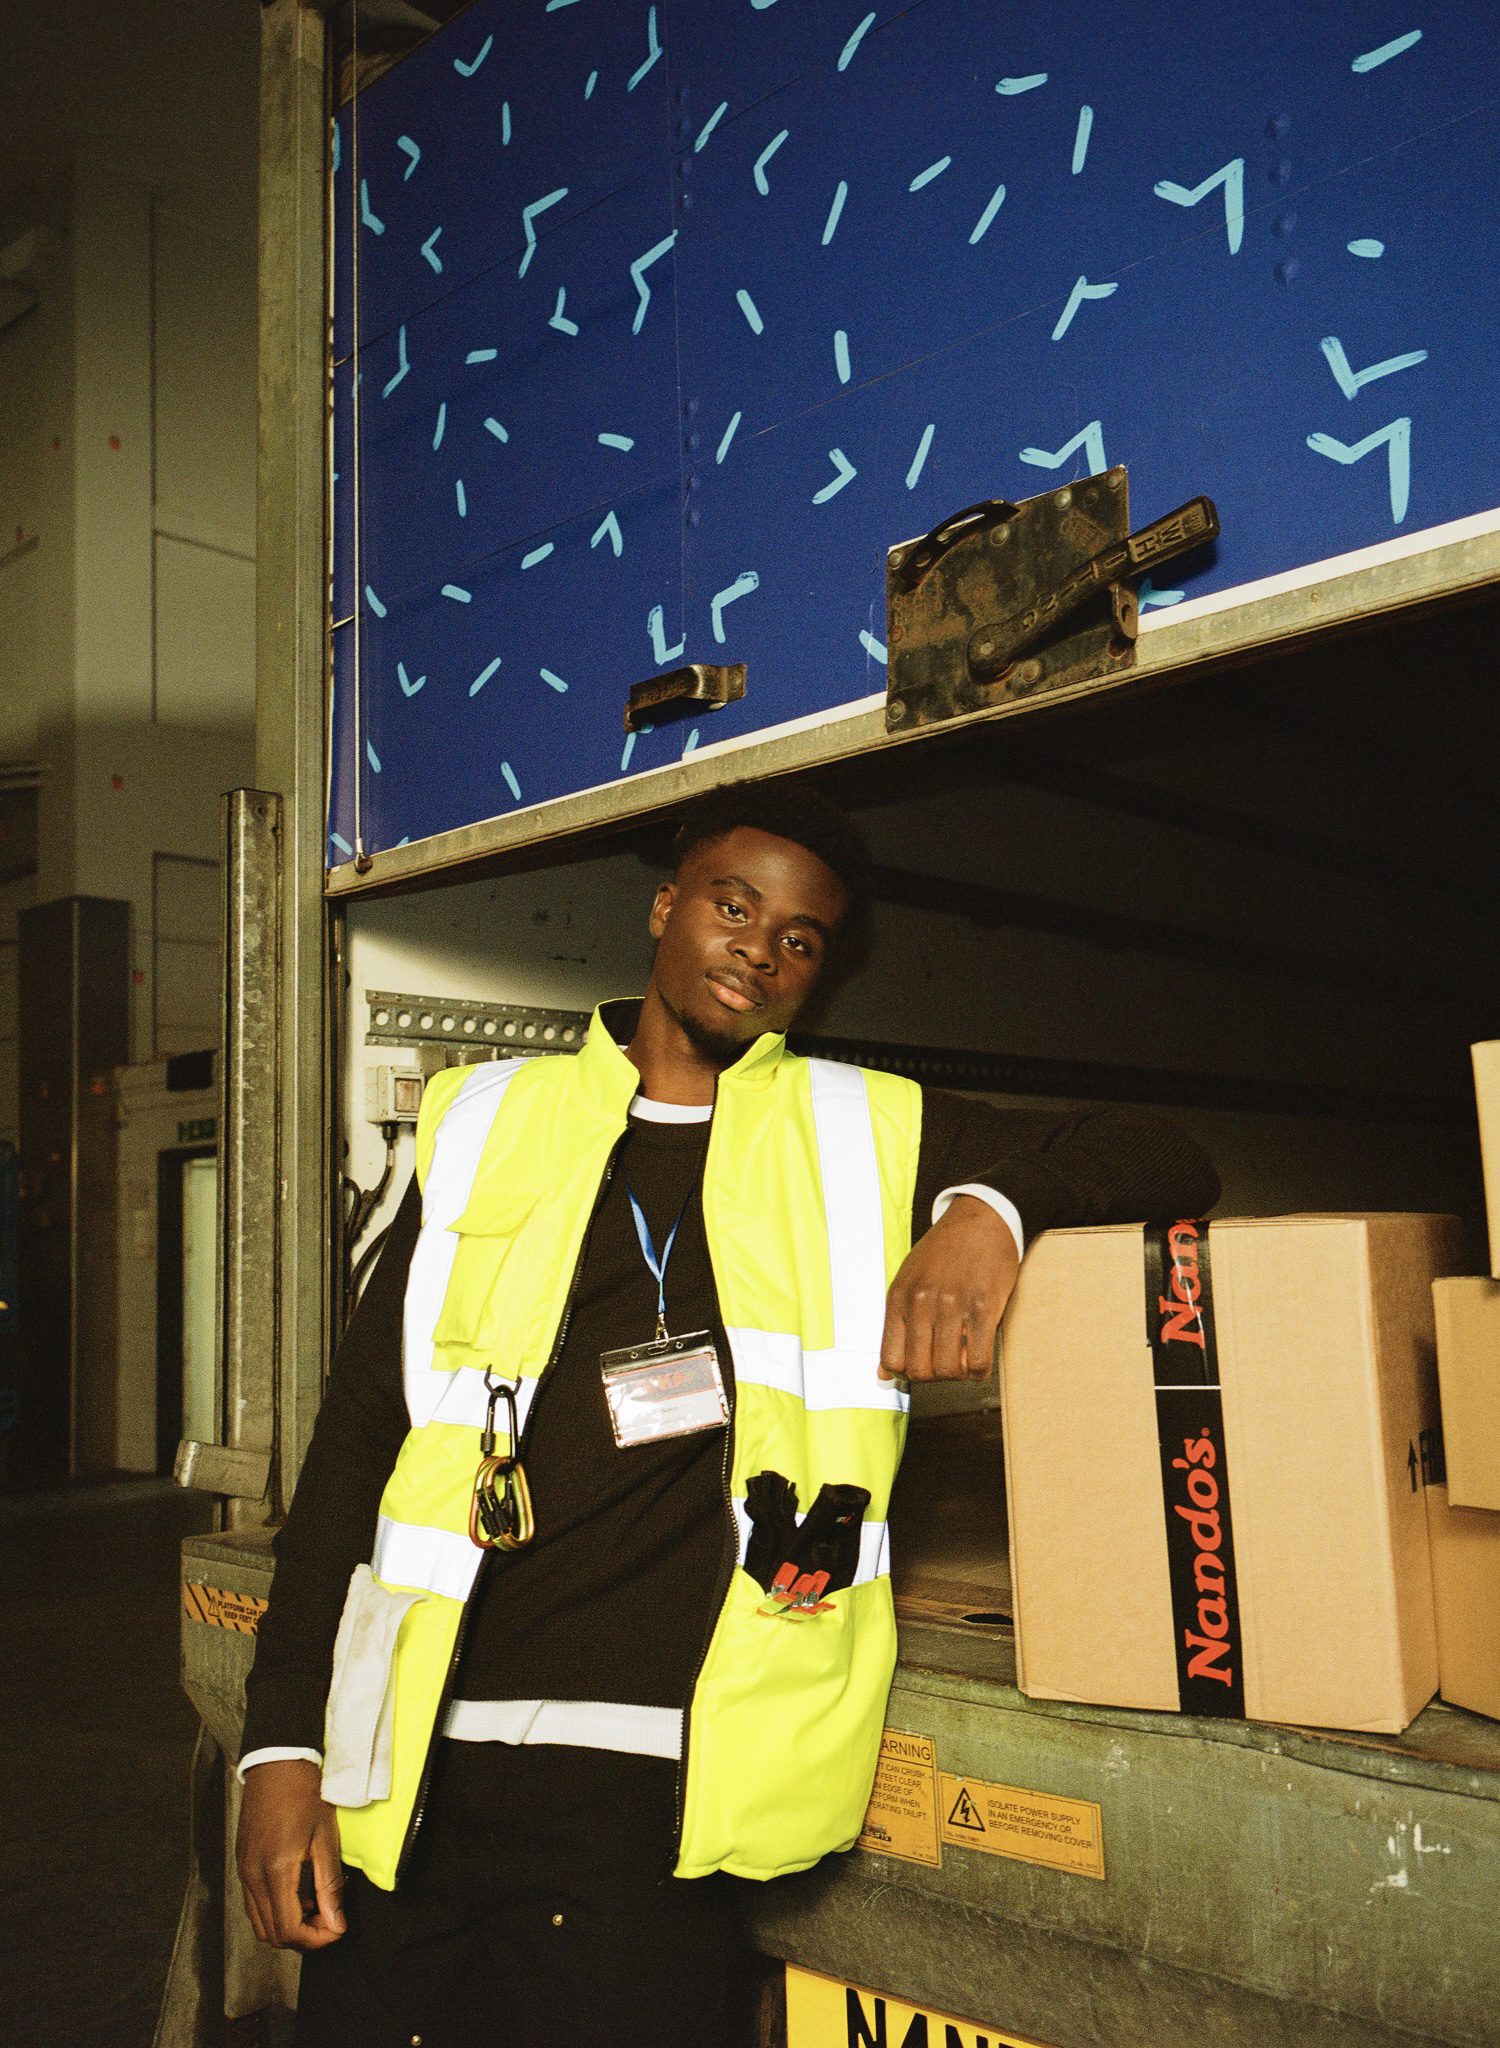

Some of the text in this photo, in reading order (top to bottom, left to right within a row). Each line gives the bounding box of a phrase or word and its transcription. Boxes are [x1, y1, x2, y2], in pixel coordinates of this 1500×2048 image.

[1158, 1220, 1206, 1349] Nan
[1173, 1437, 1234, 1688] Nando's
[881, 1739, 931, 1761] ARNING
[885, 1764, 900, 1773] CAN
[881, 1773, 898, 1783] FEET
[899, 1777, 921, 1788] CLEAR
[883, 1784, 902, 1794] EDGE
[903, 1788, 914, 1796] OF
[900, 1797, 921, 1808] WHEN
[988, 1800, 1081, 1825] ISOLATE POWER SUPPLY
[988, 1810, 997, 1818] IN
[998, 1813, 1008, 1821] AN
[1009, 1815, 1058, 1831] EMERGENCY
[988, 1820, 1093, 1849] BEFORE REMOVING COVER
